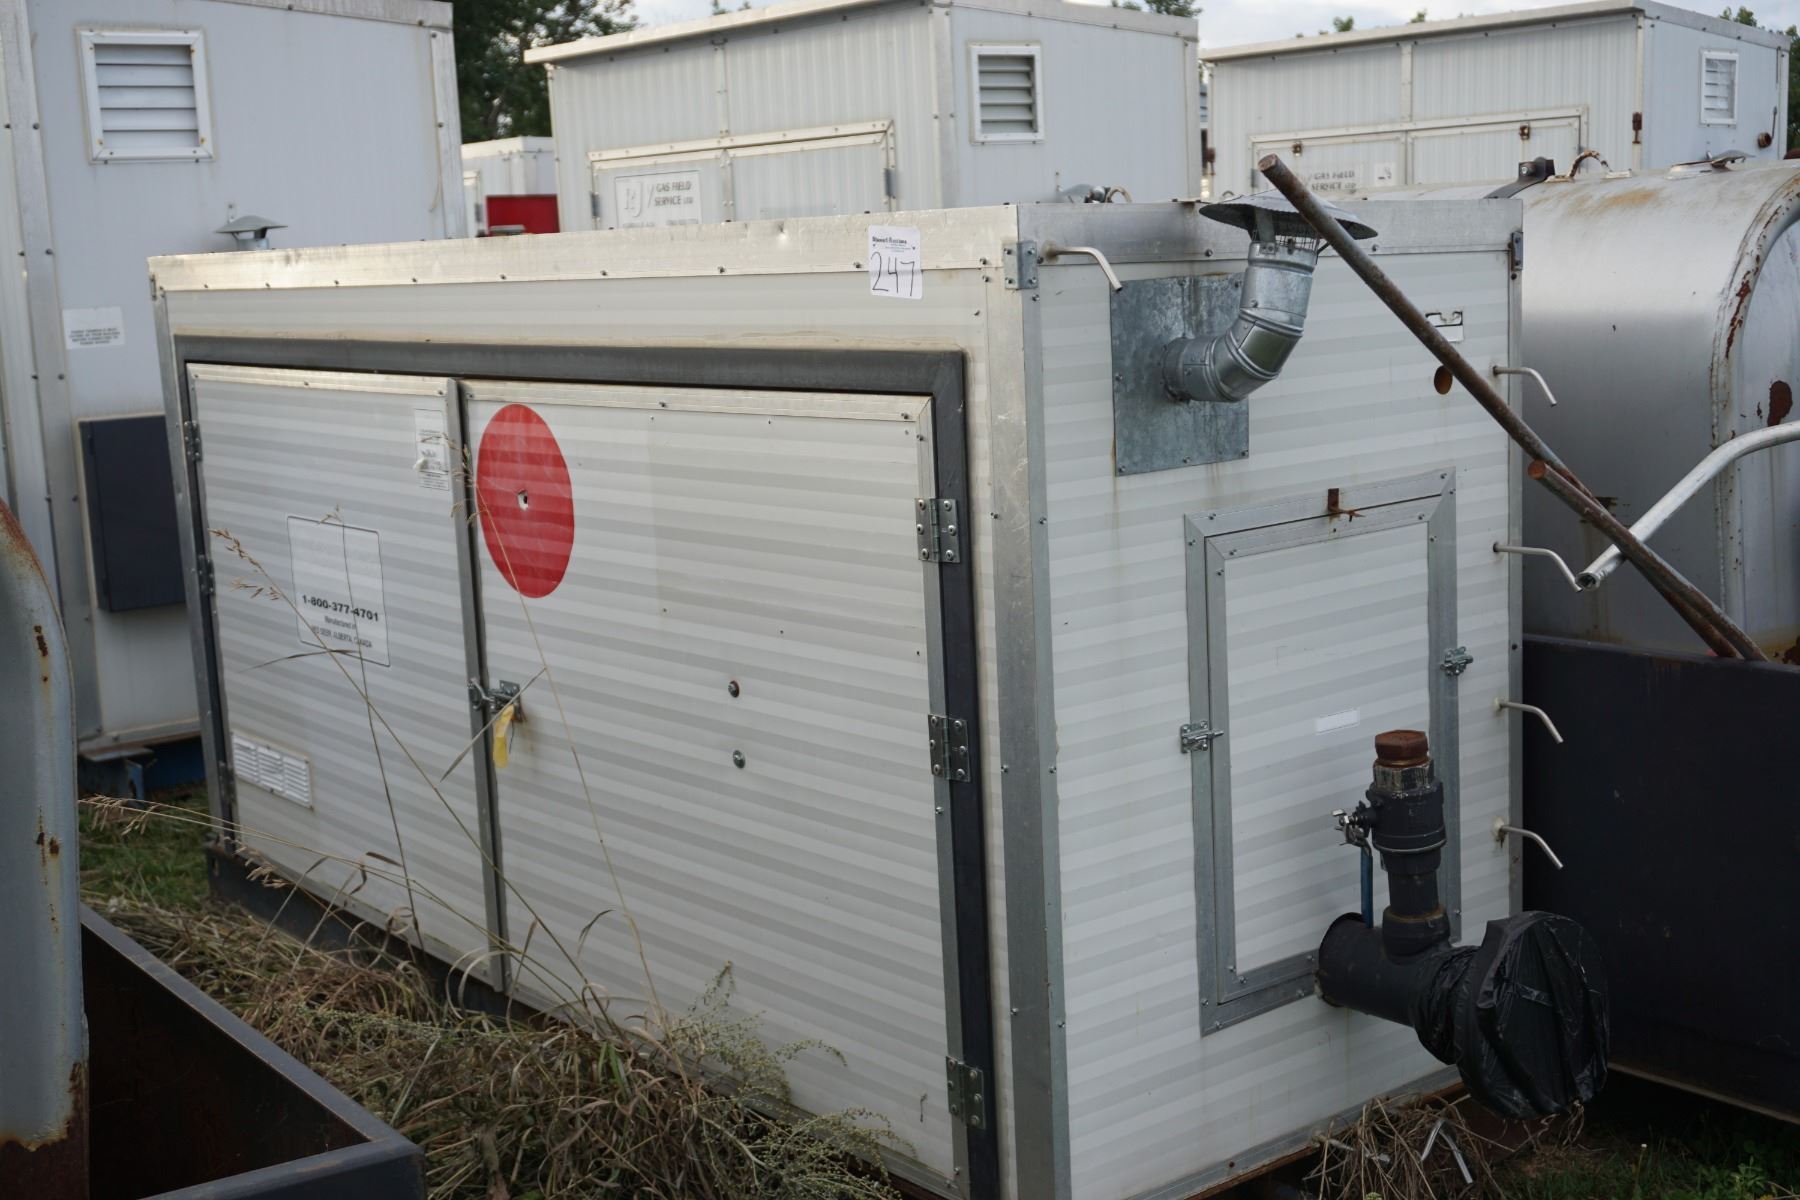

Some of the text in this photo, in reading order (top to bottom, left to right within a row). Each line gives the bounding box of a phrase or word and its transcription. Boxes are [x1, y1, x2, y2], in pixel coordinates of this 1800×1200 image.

[656, 180, 692, 192] GAS FIELD
[655, 195, 681, 206] SERVICE
[870, 251, 915, 297] 247
[302, 594, 379, 622] 1-800-377-4701
